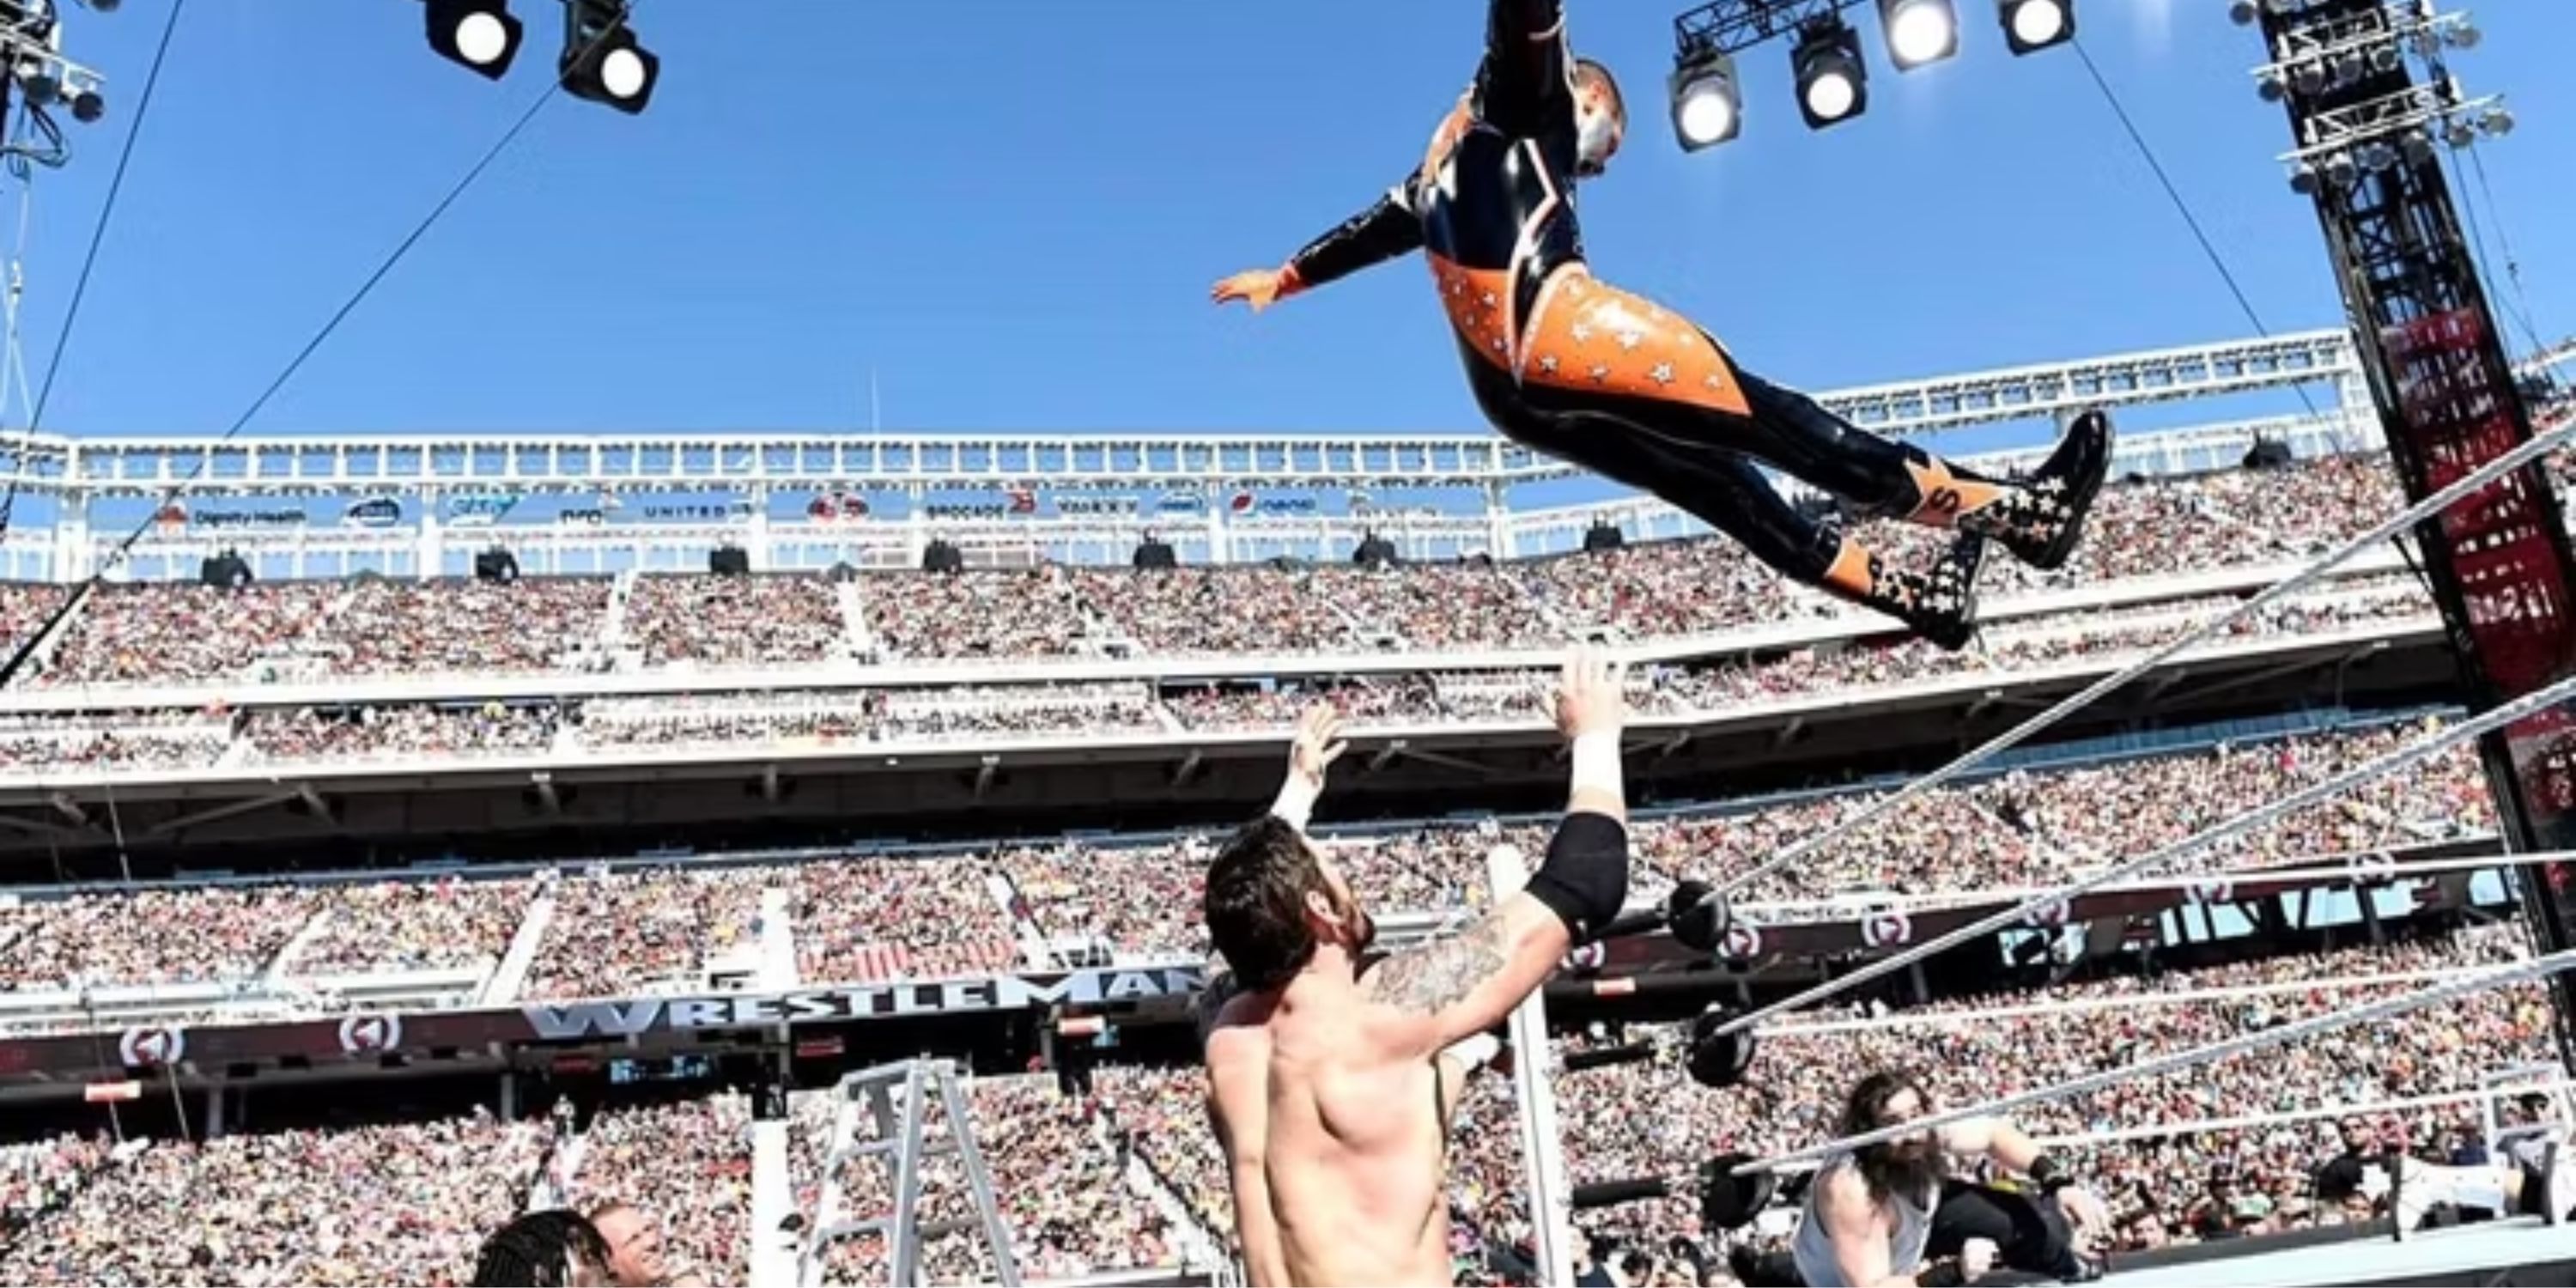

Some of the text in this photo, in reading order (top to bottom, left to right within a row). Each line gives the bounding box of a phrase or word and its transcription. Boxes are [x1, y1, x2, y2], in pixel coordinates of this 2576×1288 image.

[644, 505, 726, 517] UNITED
[194, 510, 307, 528] Dignity Health
